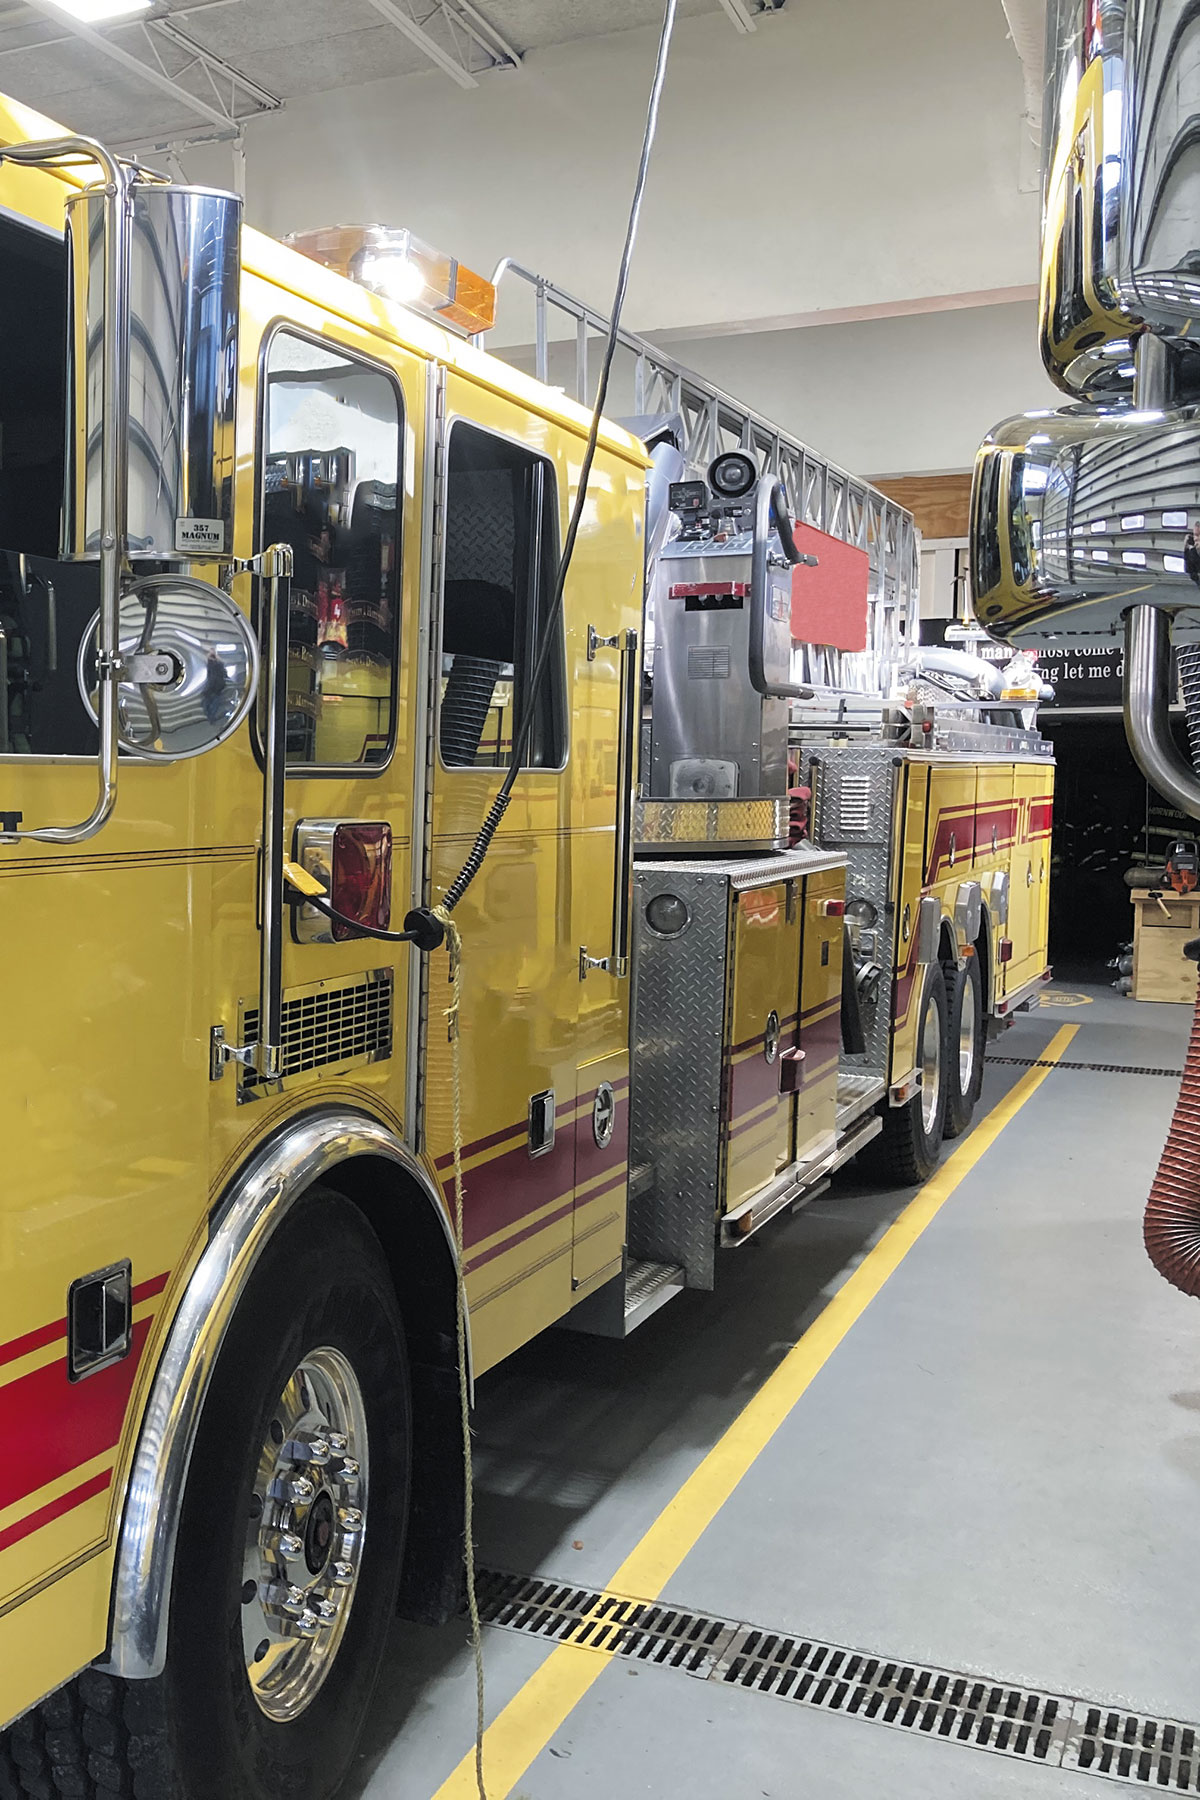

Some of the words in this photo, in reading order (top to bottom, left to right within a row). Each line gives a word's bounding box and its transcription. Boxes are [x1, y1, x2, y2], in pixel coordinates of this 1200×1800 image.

[193, 524, 209, 532] 357
[181, 532, 220, 540] MAGNUM
[1064, 663, 1086, 681] let
[1090, 666, 1114, 680] me
